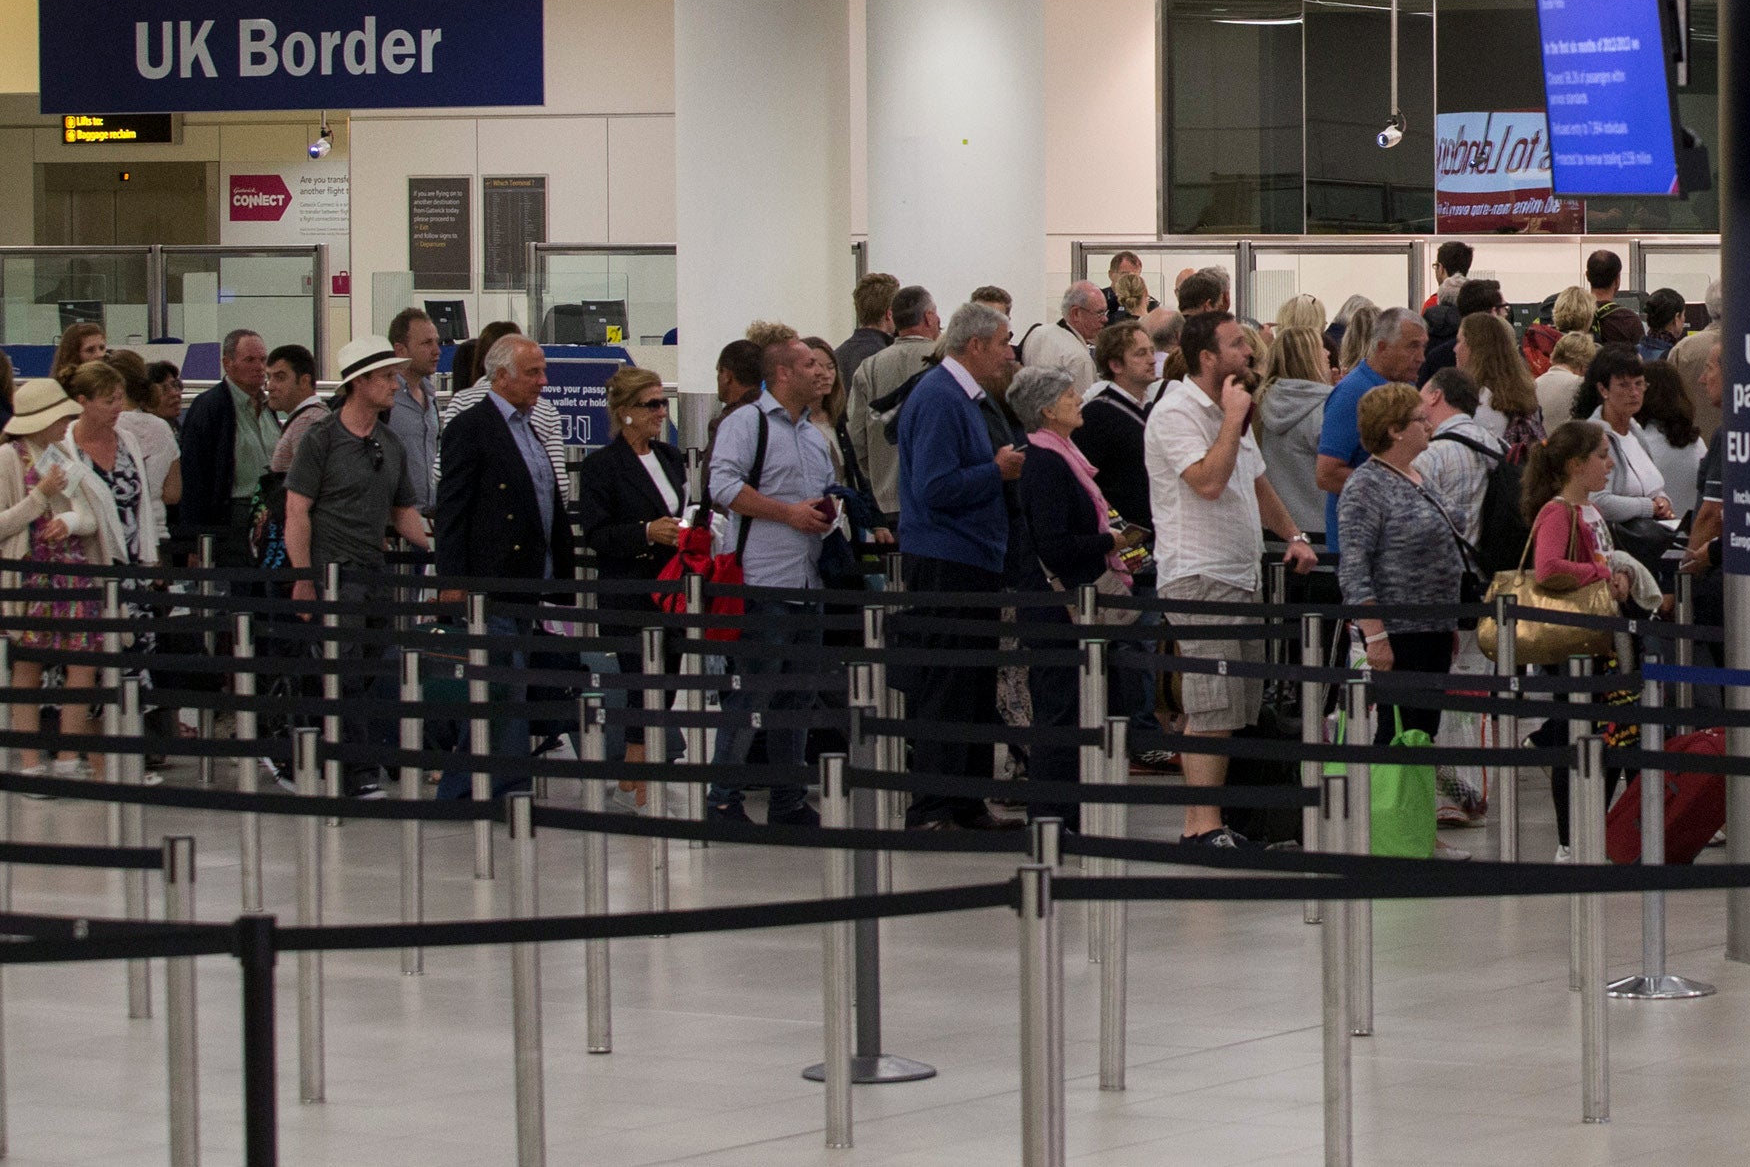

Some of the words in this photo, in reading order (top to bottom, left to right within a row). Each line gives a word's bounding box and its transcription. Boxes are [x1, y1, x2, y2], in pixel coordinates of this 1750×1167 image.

[135, 20, 218, 80] UK
[239, 15, 442, 77] Border
[300, 176, 312, 184] Are
[300, 187, 325, 195] another
[327, 187, 345, 196] flight
[233, 192, 285, 209] CONNECT
[563, 386, 580, 394] your
[553, 398, 577, 406] wallet
[1727, 431, 1749, 463] EU
